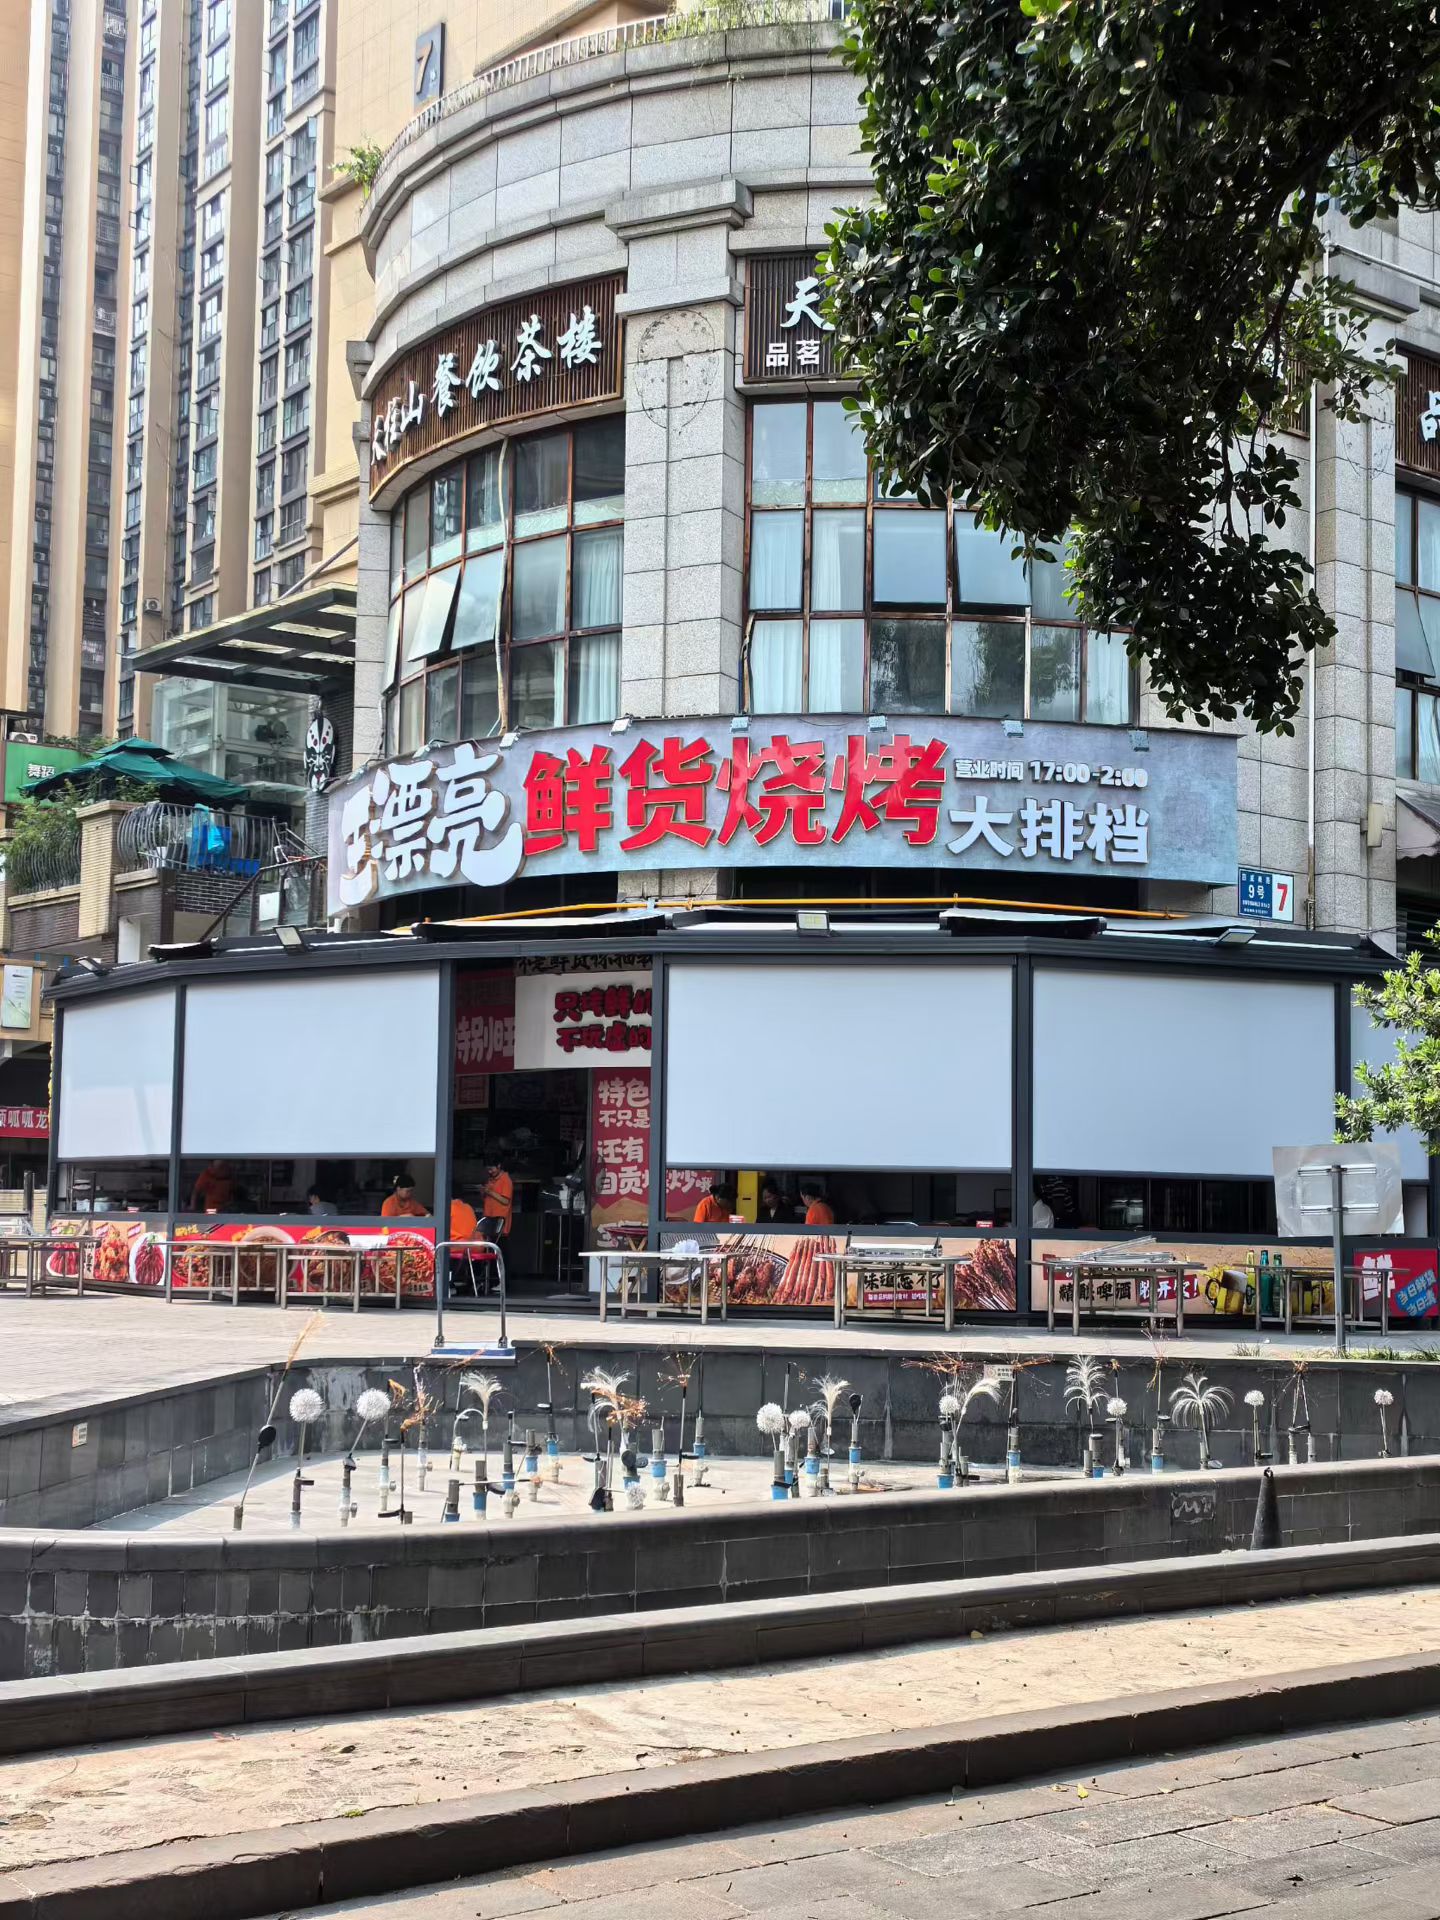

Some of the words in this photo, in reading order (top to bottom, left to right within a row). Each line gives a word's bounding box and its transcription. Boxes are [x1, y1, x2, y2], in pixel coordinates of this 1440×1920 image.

[954, 759, 1024, 780] 营业时间
[1029, 760, 1149, 788] 17:00-2:00
[523, 734, 949, 857] 鲜货烧烤
[947, 795, 1150, 864] 大排档
[1276, 882, 1288, 912] 7
[598, 1077, 651, 1108] 特色
[598, 1108, 651, 1129] 不只是
[597, 1136, 644, 1164] 还有
